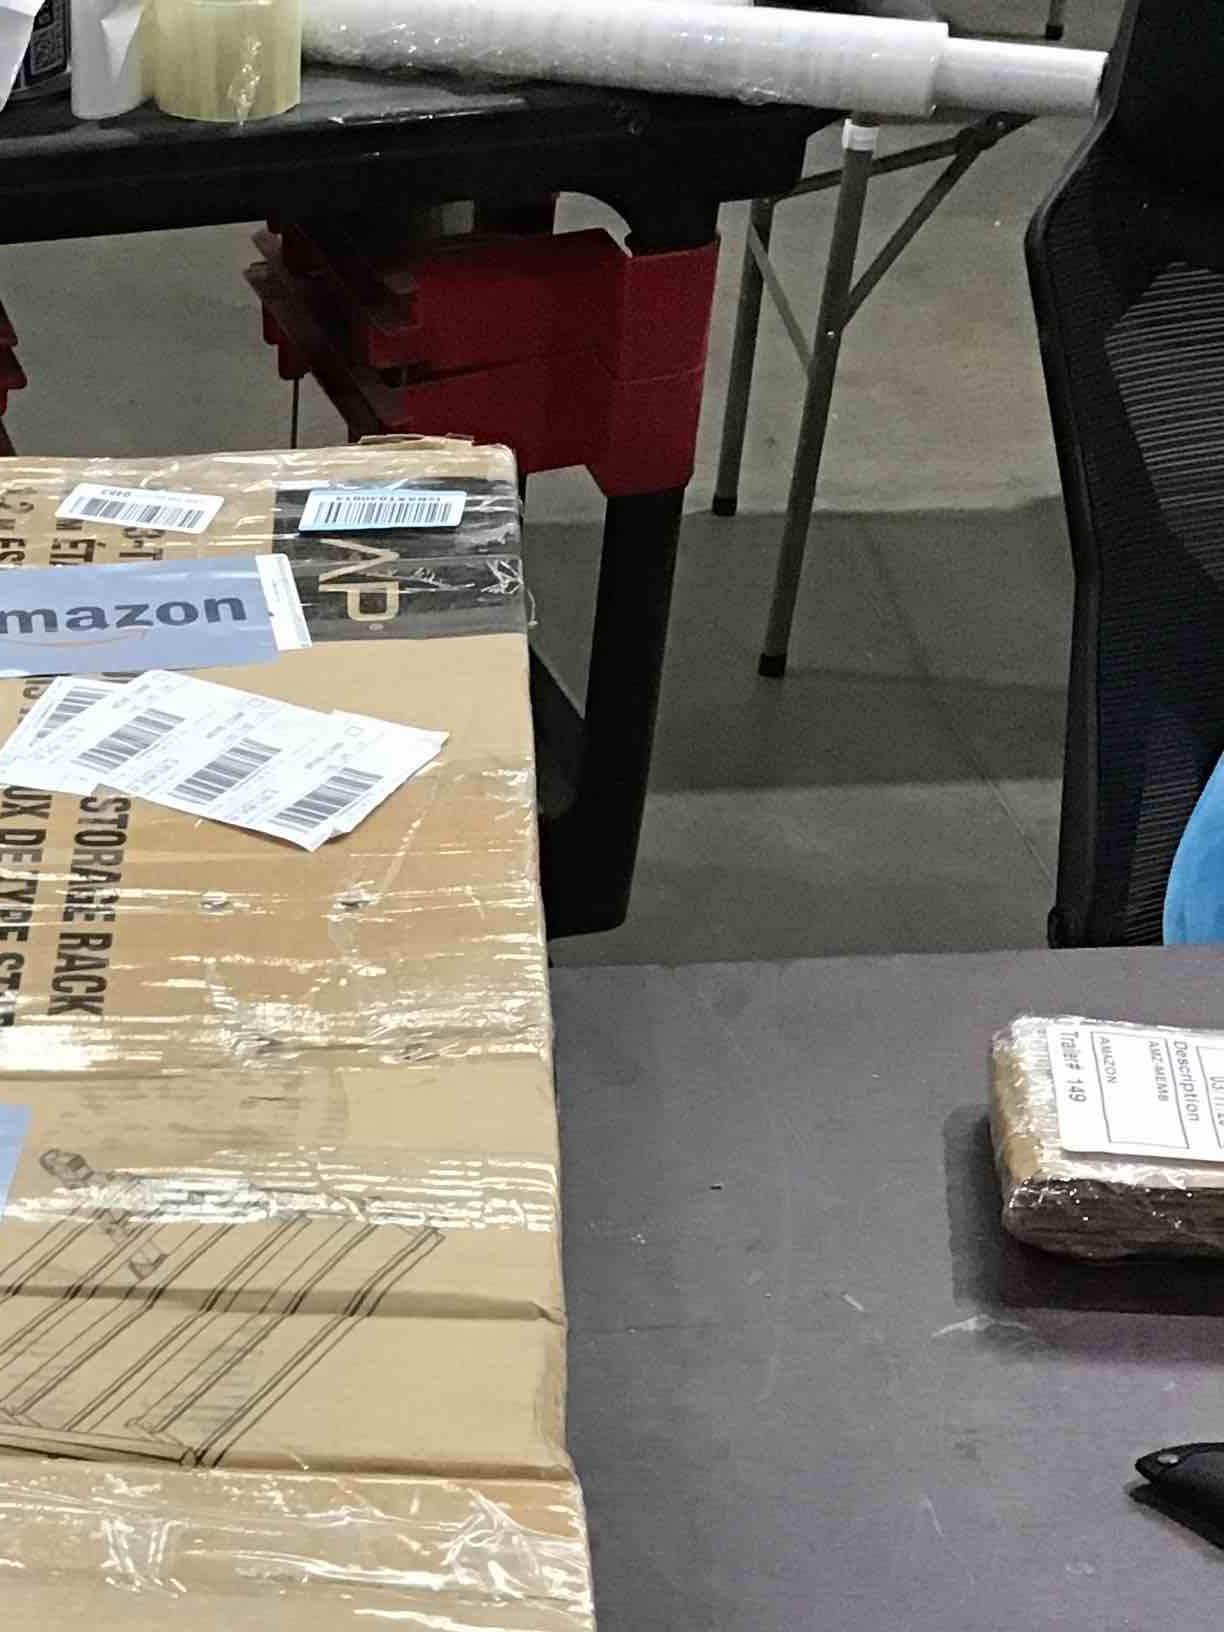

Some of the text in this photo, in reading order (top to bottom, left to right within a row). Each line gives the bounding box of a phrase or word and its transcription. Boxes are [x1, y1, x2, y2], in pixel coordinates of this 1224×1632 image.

[47, 931, 114, 1016] RACK
[1066, 1079, 1088, 1103] 149
[1100, 1036, 1117, 1084] AMAZON
[1173, 1040, 1201, 1122] Description
